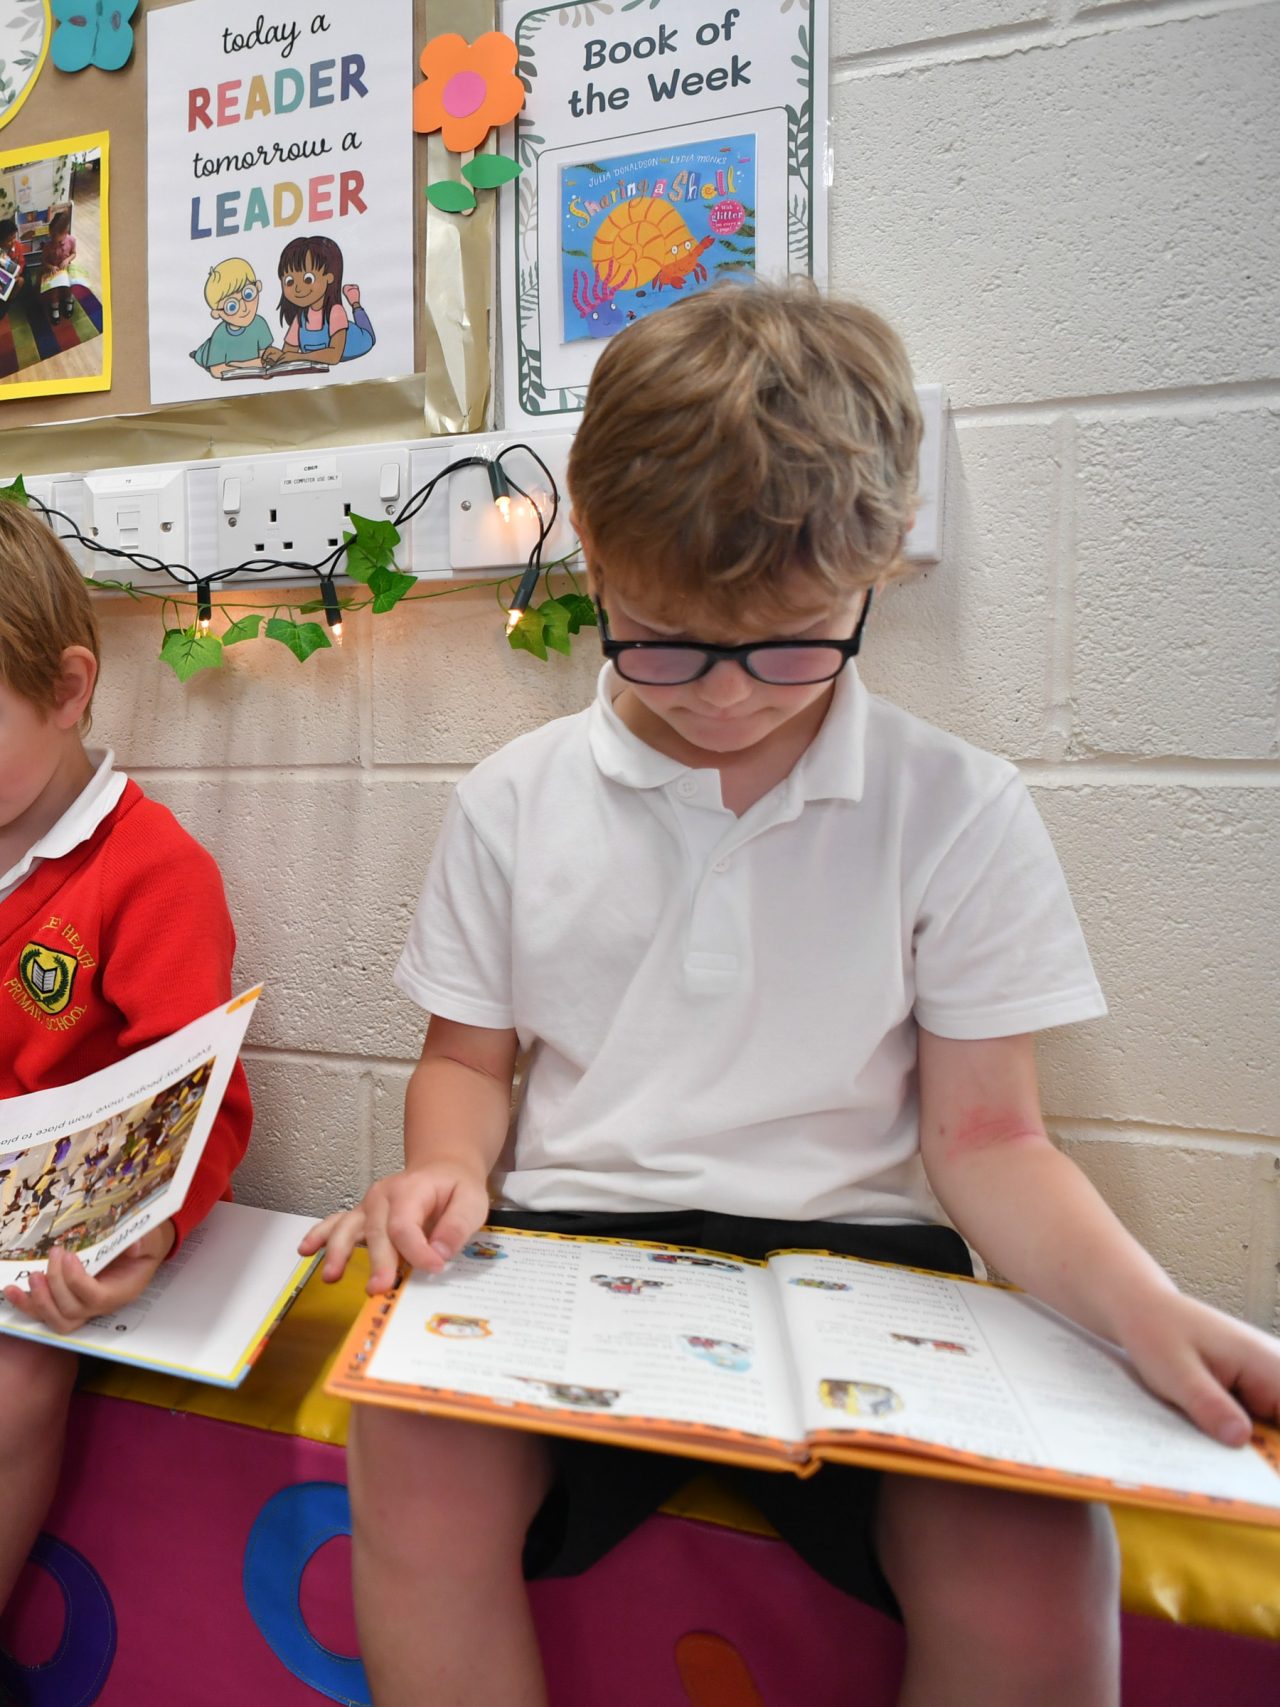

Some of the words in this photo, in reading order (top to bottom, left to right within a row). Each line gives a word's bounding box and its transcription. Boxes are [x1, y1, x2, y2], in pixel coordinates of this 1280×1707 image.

[222, 14, 301, 59] today
[310, 14, 331, 34] a
[583, 24, 678, 71] Book
[695, 8, 740, 46] of
[188, 53, 369, 133] READER
[568, 82, 630, 118] the
[647, 54, 752, 102] Week
[192, 138, 332, 179] tomorrow
[341, 131, 363, 151] a
[588, 172, 611, 188] JULIA
[613, 157, 659, 177] DONALDSON
[670, 154, 694, 165] LYDIA
[190, 170, 368, 241] LEADER
[569, 178, 650, 228] Sharing
[668, 165, 736, 203] Shell
[711, 211, 743, 222] glitter
[61, 923, 97, 969] HEATH
[3, 977, 42, 1021] PRIMAR
[95, 1098, 124, 1115] move
[126, 1075, 163, 1100] people
[21, 1133, 33, 1142] to
[35, 1121, 66, 1138] place
[68, 1111, 93, 1126] from
